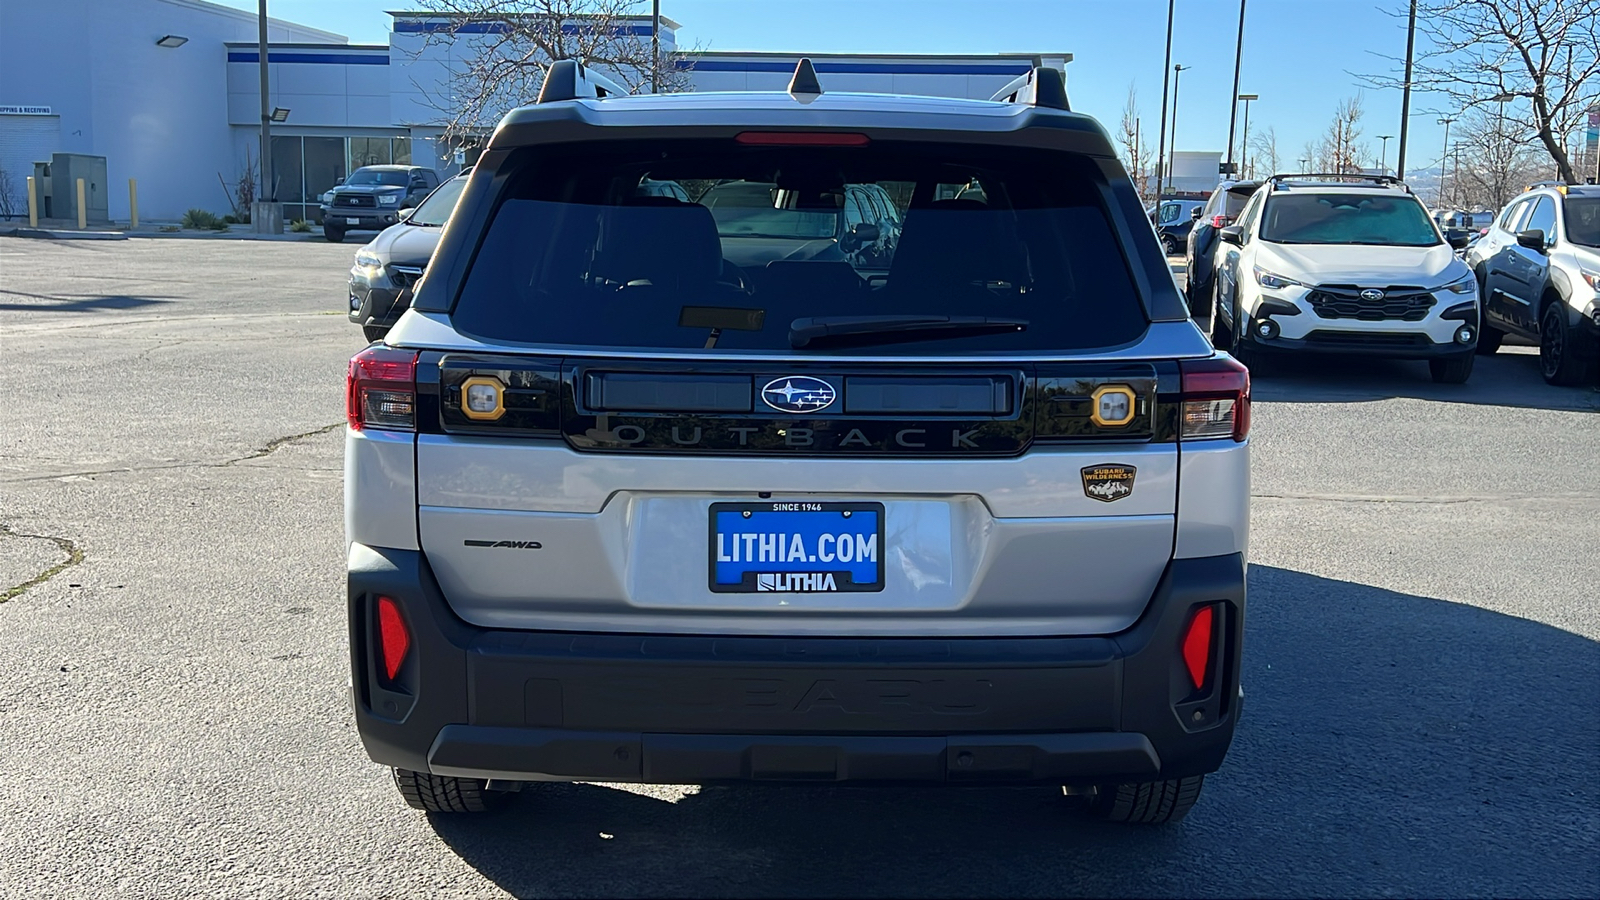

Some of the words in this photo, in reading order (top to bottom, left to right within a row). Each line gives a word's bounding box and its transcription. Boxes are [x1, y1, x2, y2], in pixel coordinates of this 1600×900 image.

[612, 424, 980, 447] OUTBACK
[773, 503, 799, 511] SINCE
[801, 503, 822, 511] 1946
[492, 540, 542, 549] AWD
[717, 533, 878, 562] LITHIA.COM
[775, 573, 837, 591] LITHIA
[602, 677, 991, 715] BARU
